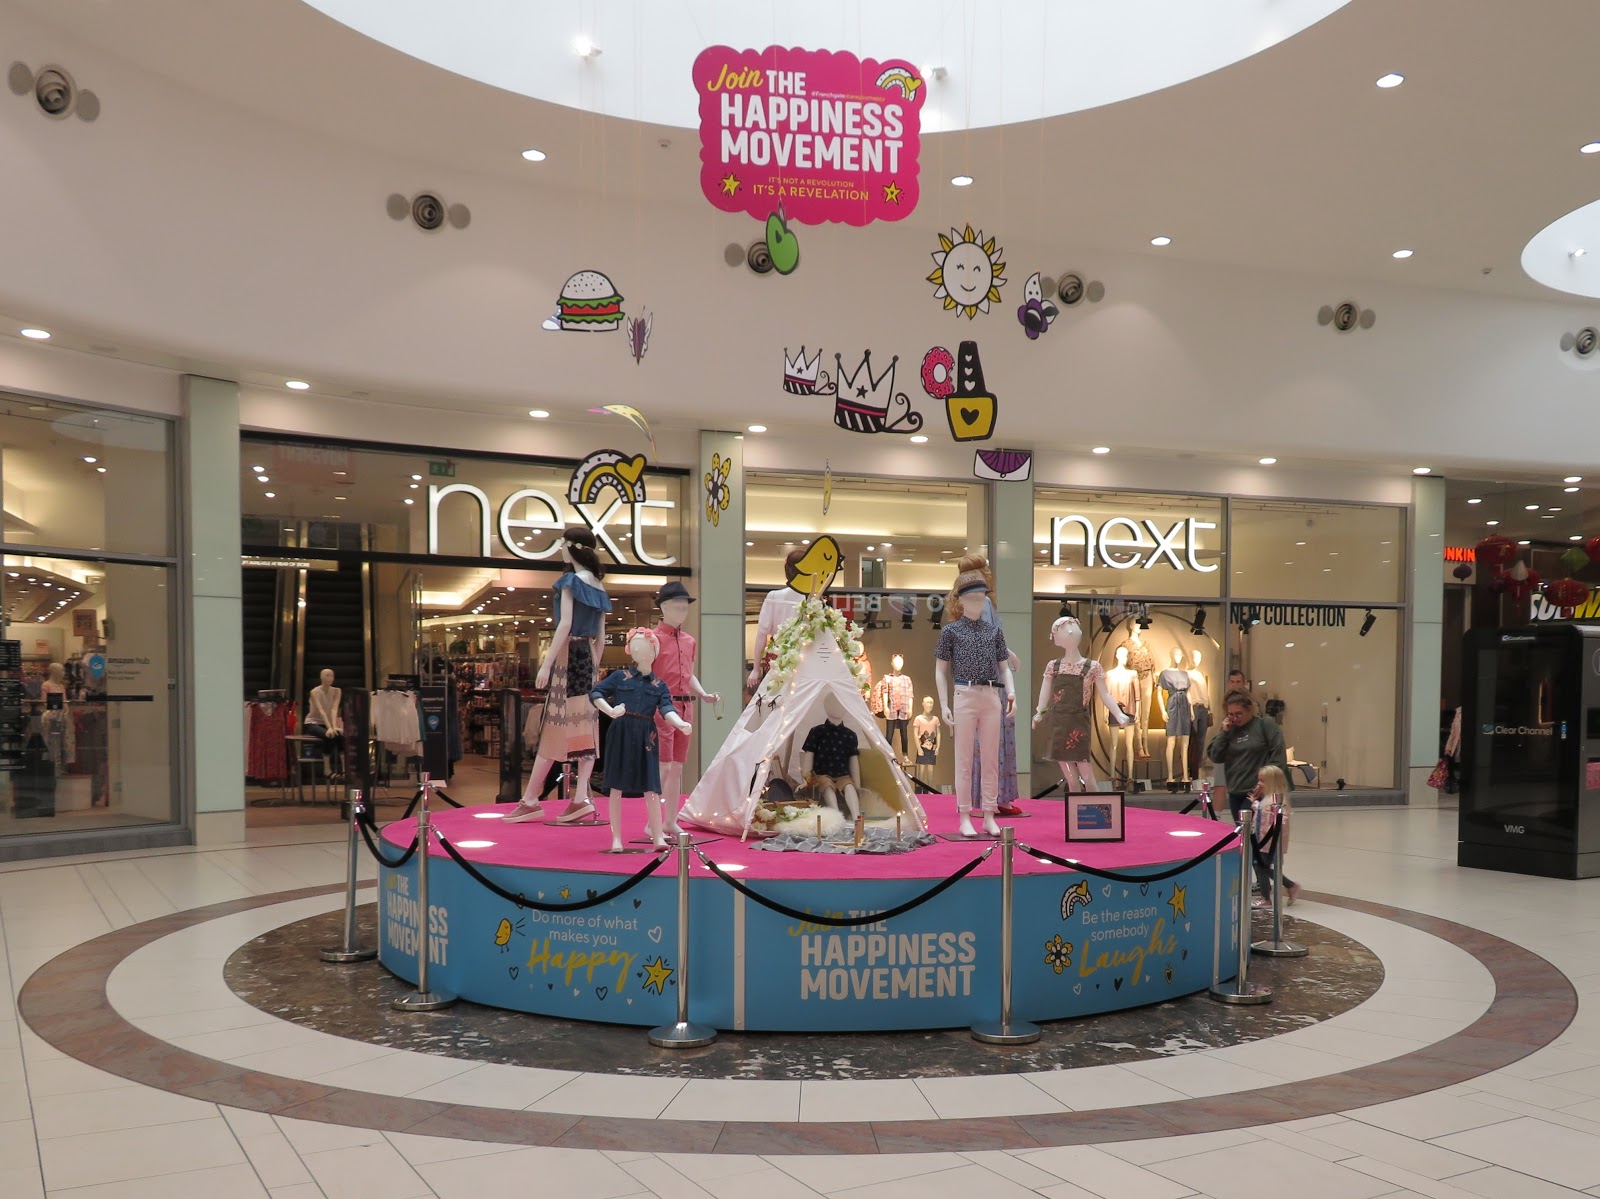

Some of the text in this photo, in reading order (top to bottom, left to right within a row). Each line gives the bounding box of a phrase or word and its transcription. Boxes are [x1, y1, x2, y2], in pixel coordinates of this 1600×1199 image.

[707, 63, 806, 95] Join THE
[720, 92, 903, 138] HAPPINESS
[721, 129, 903, 173] MOVEMENT
[753, 184, 869, 200] IT'S A REVELATION
[768, 176, 781, 184] IT'S
[807, 178, 854, 188] REVOLUTION
[428, 483, 677, 566] next
[1051, 514, 1219, 573] next
[1264, 605, 1345, 627] COLLECTION
[1495, 725, 1517, 735] Clear
[1518, 726, 1553, 736] Channel
[1504, 824, 1525, 834] VMG
[387, 890, 448, 936] HAPPINSS
[532, 909, 638, 931] Do more of what
[848, 910, 888, 932] THE
[1081, 906, 1157, 925] Be the reason
[387, 918, 448, 966] MOVEMNT
[549, 930, 617, 947] makes you
[801, 931, 976, 966] HAPPINESS
[1091, 923, 1150, 942] somebody
[527, 938, 638, 993] Happy
[1079, 917, 1178, 986] Laughs
[801, 964, 976, 1000] MOVEMENT
